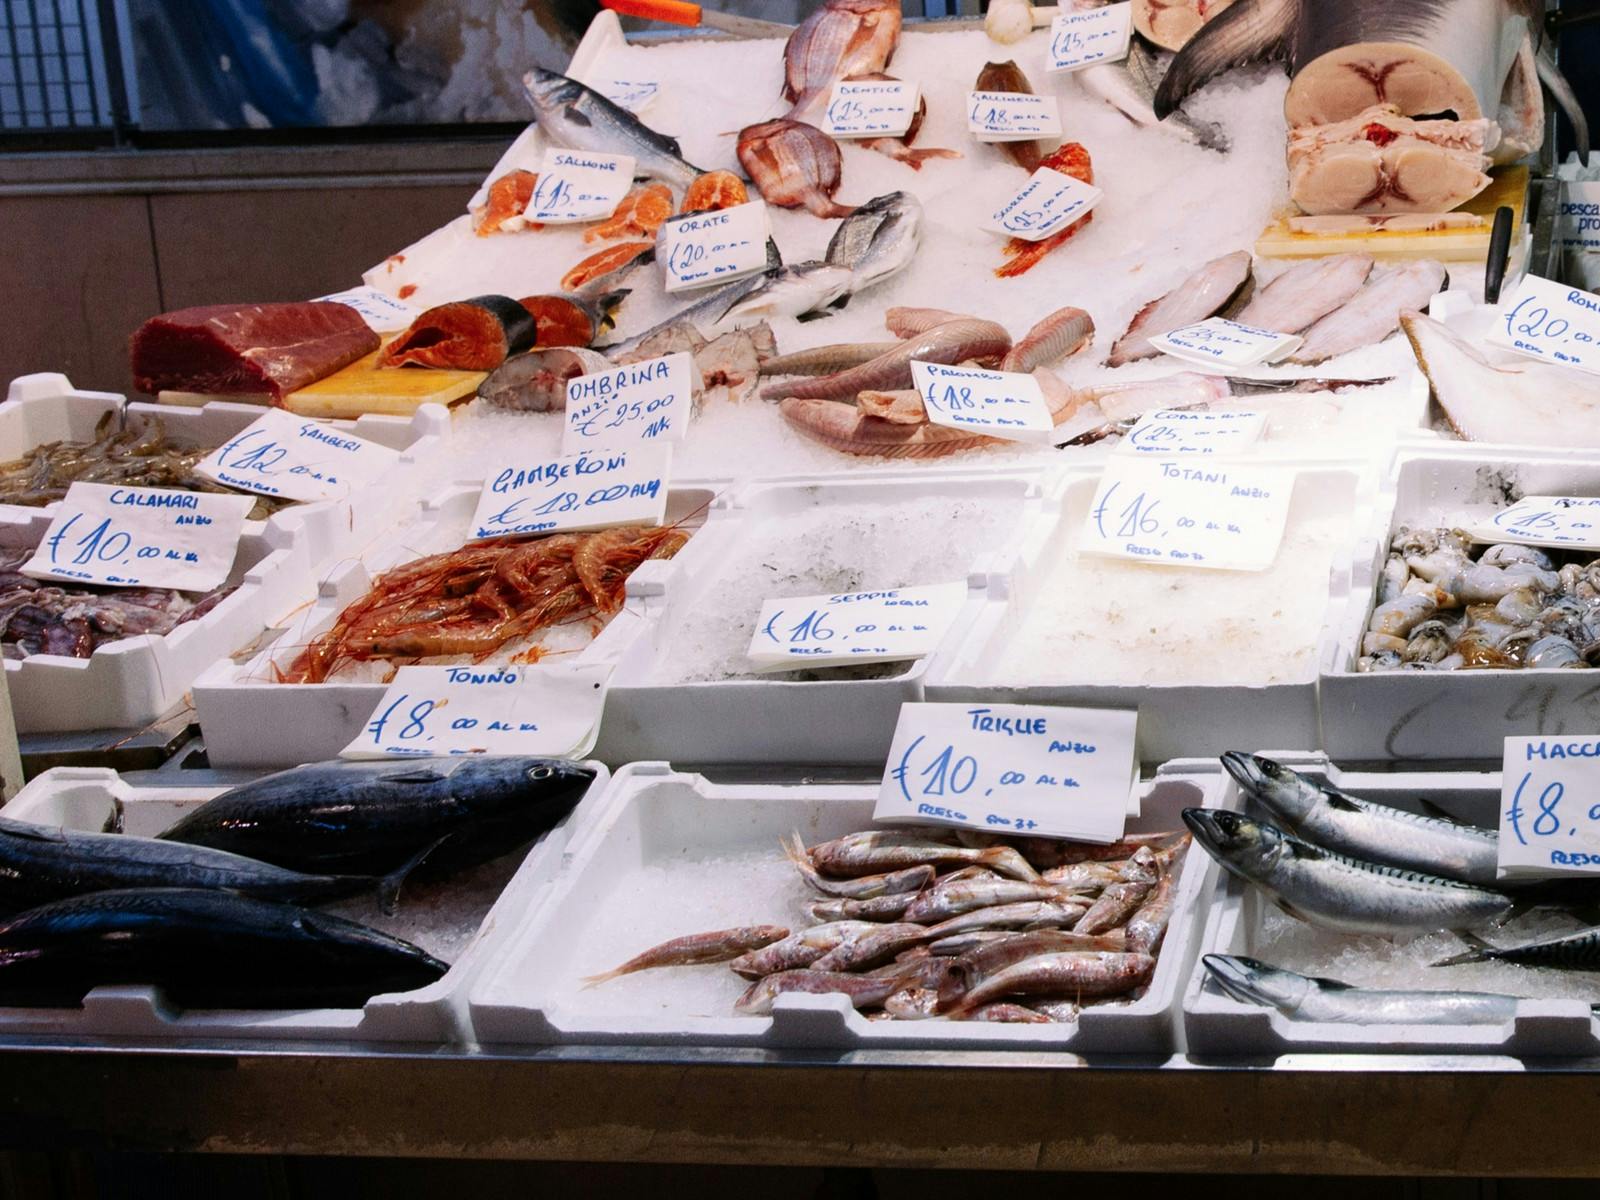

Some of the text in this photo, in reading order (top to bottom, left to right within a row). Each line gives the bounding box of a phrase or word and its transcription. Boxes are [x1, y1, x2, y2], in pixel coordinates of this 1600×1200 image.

[555, 155, 617, 171] SALMONE
[680, 214, 730, 234] ORATE
[299, 424, 363, 452] GAMBERI
[1160, 463, 1226, 484] TOTANI
[110, 490, 199, 510] CALAMARI
[1231, 486, 1270, 498] ANZIO
[827, 590, 899, 605] SEPPIE
[446, 667, 517, 685] TONNO
[968, 708, 1047, 737] TRIGLIE
